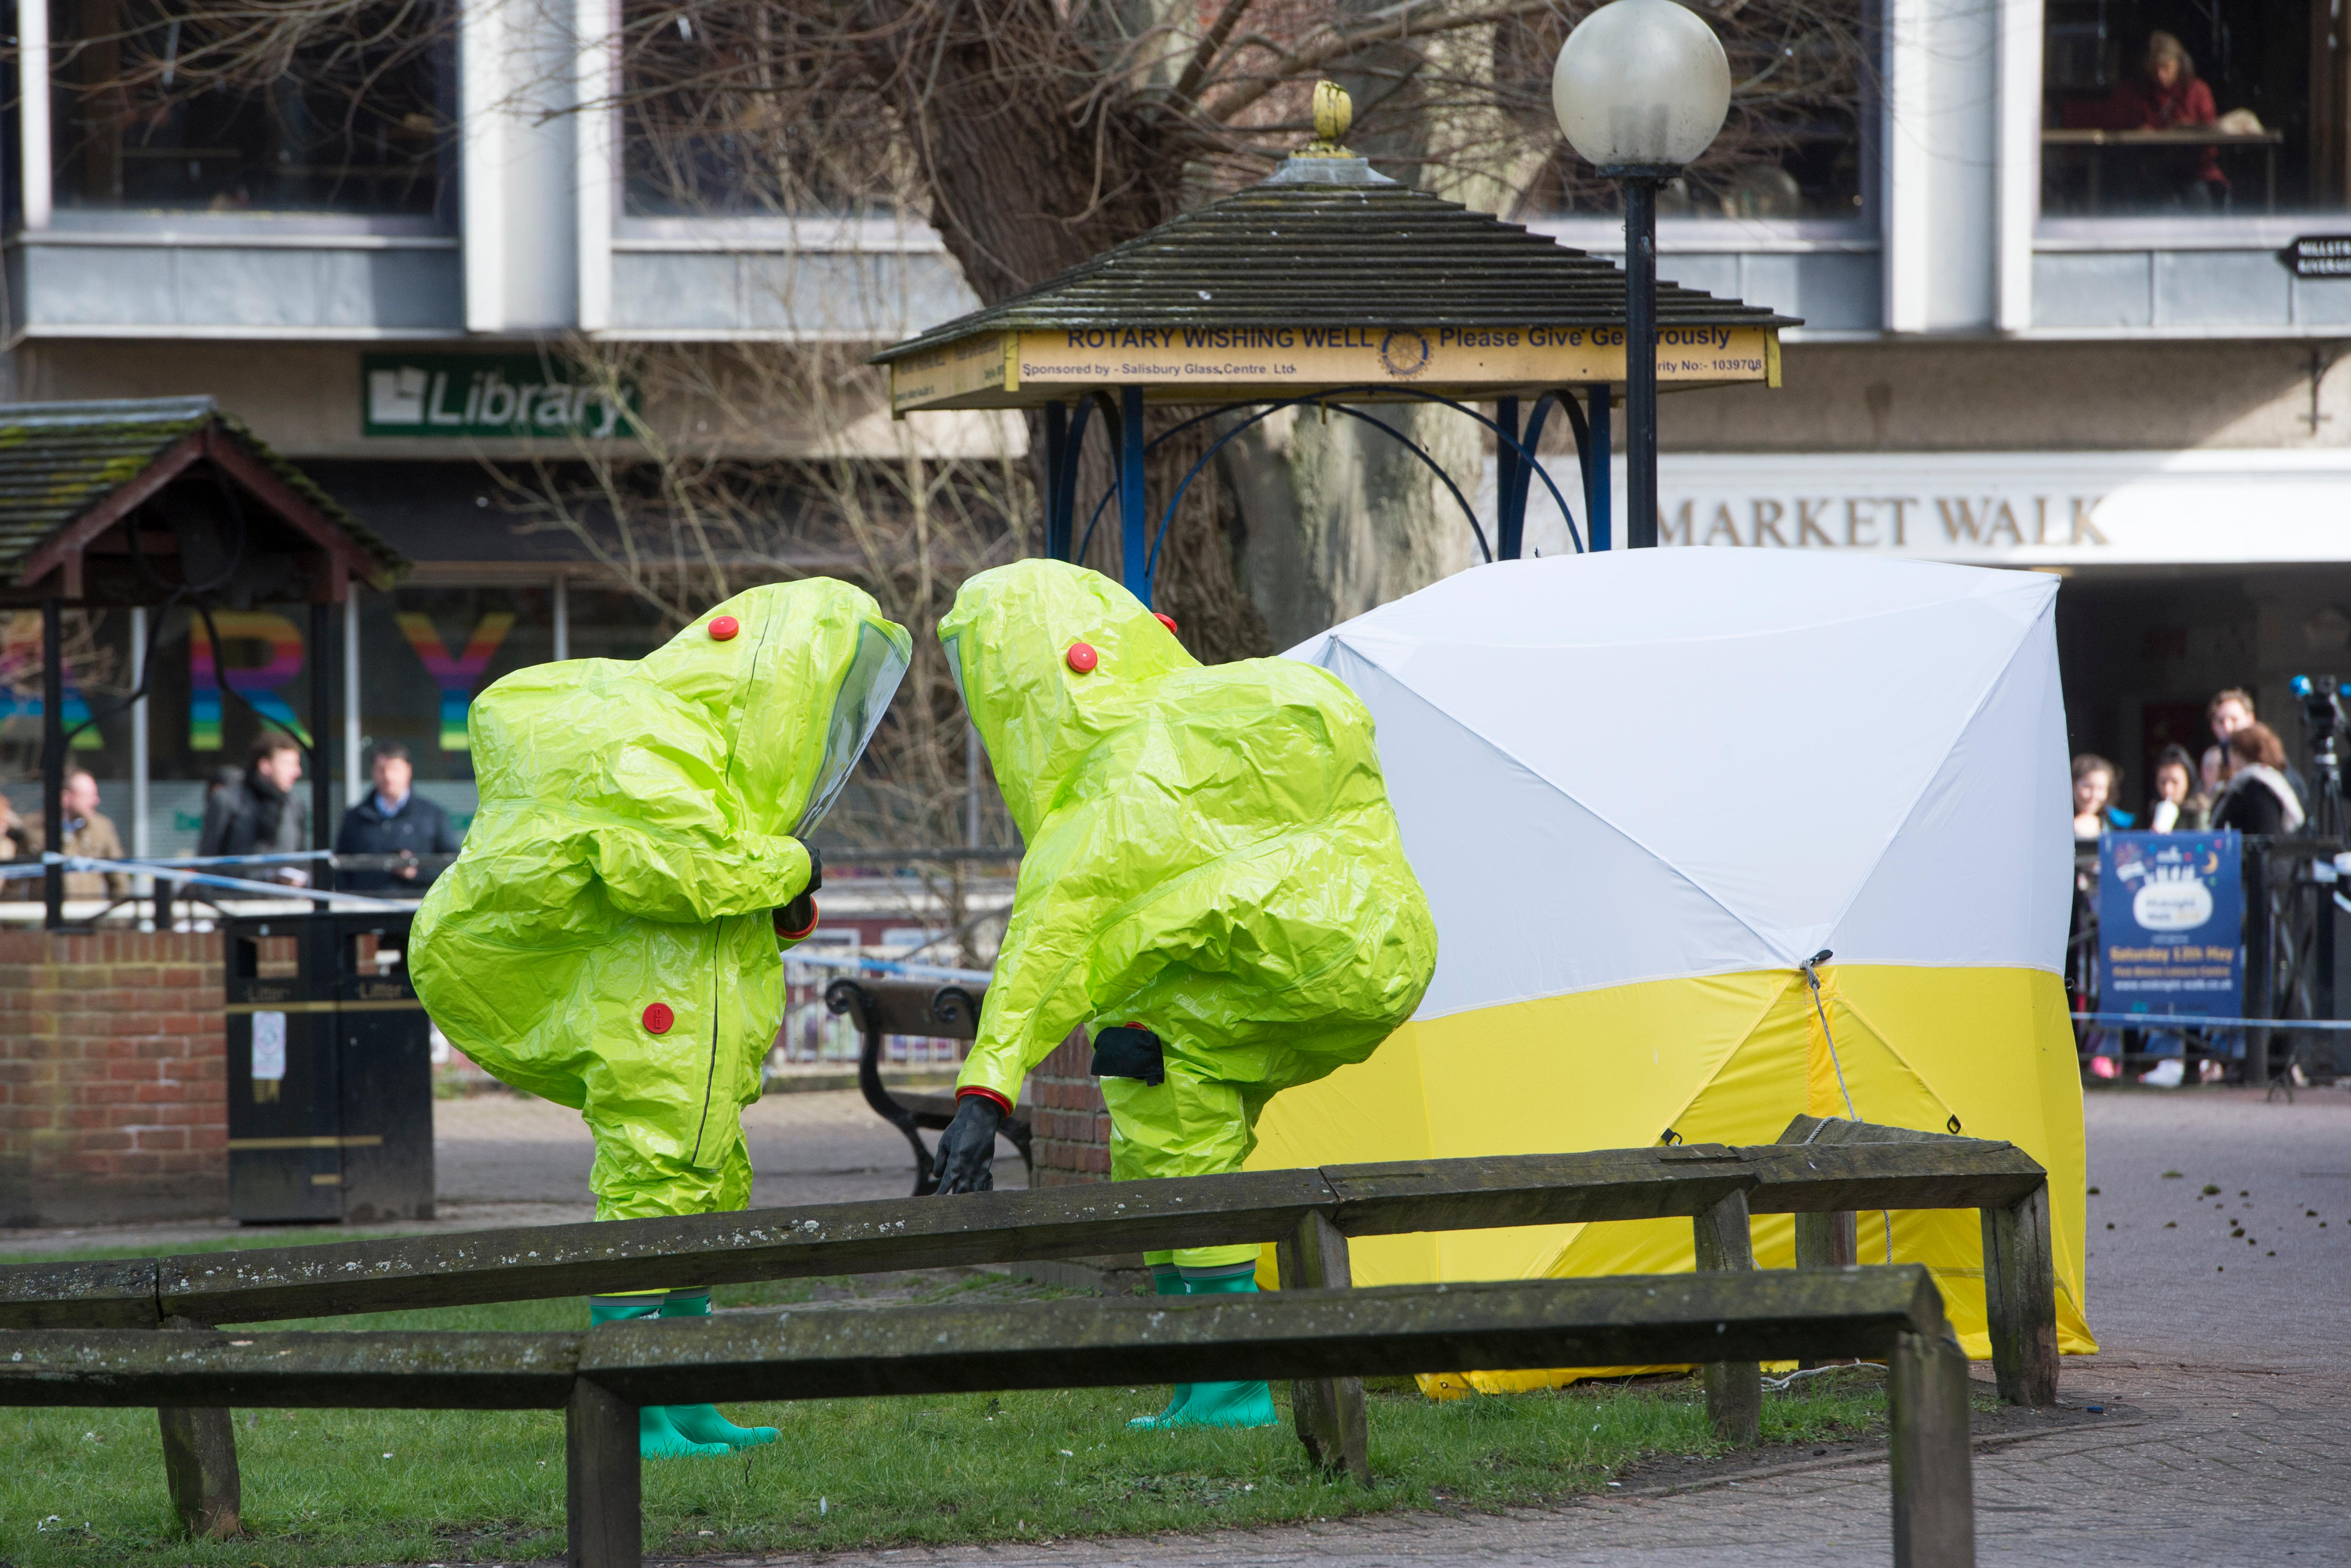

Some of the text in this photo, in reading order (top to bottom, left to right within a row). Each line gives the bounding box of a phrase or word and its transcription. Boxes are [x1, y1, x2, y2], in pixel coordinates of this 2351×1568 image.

[1068, 328, 1374, 348] ROTARY WISHING WELL
[1440, 326, 1730, 350] Please Give Gerously
[1022, 363, 1091, 376] Sponsored
[1095, 363, 1109, 377] by
[1122, 363, 1180, 376] Salisbury
[1223, 363, 1266, 374] Centre
[428, 371, 634, 438] Library
[1657, 495, 2112, 548] MARKET WALK
[2109, 946, 2169, 963] Saturday
[2205, 946, 2233, 963] May
